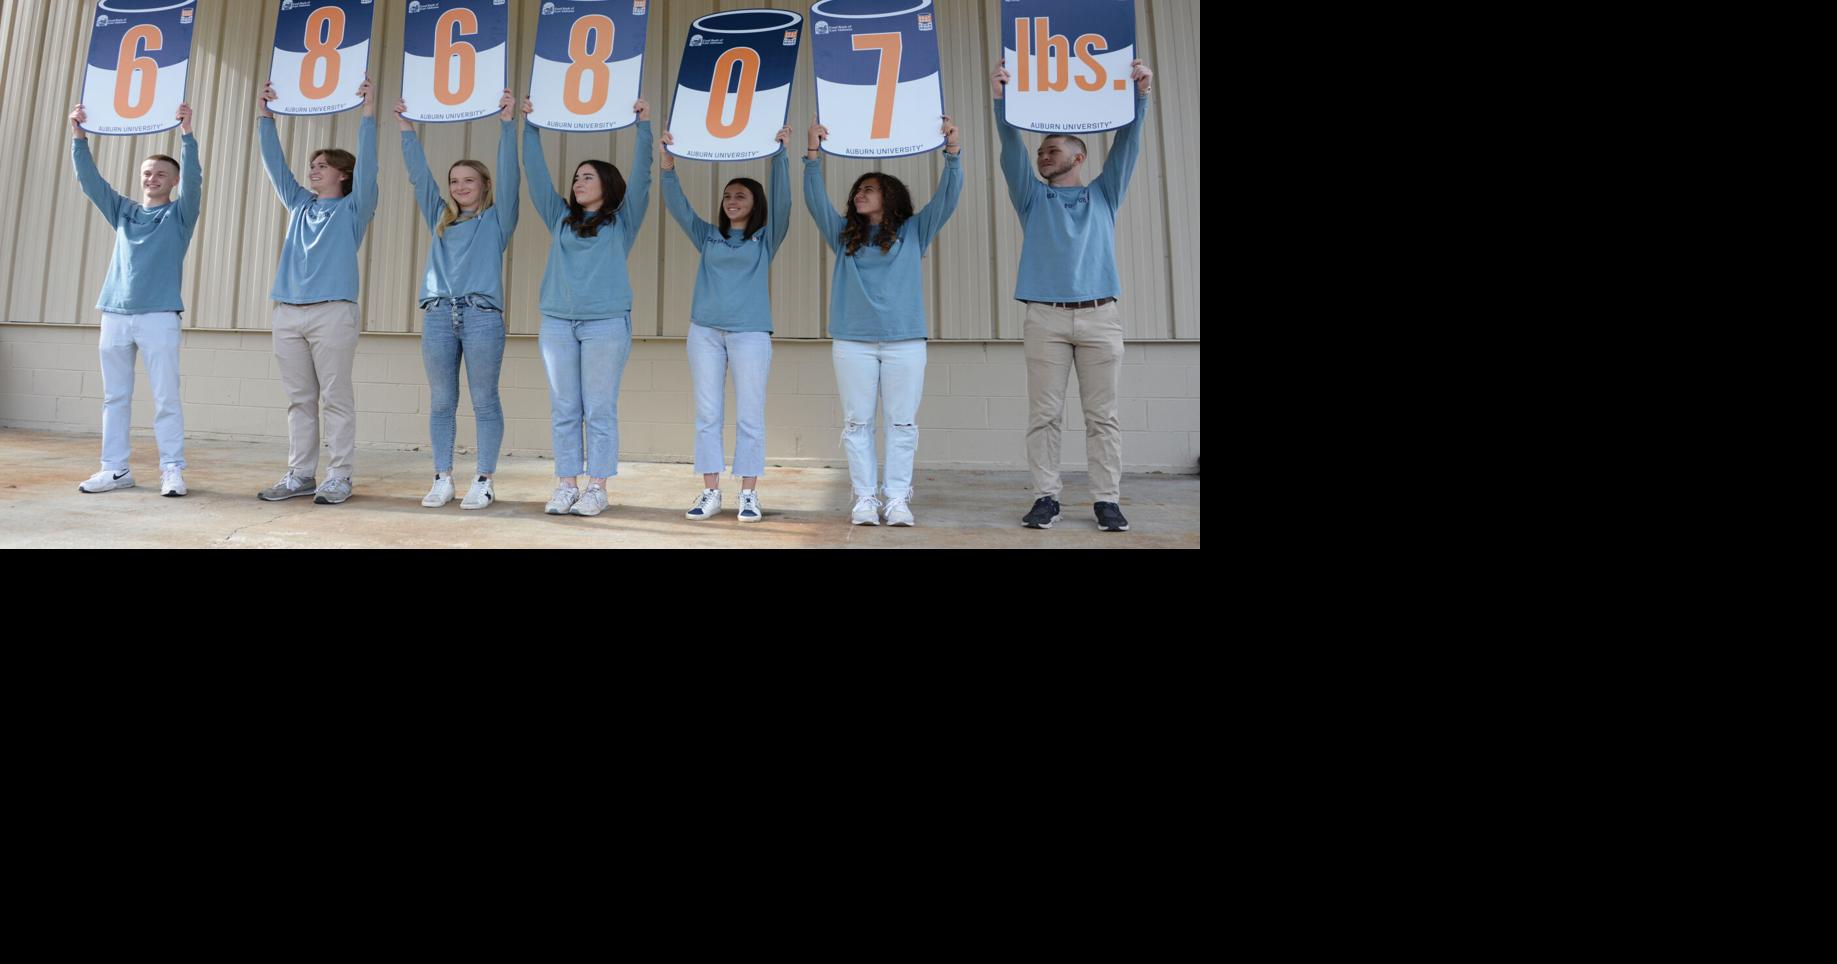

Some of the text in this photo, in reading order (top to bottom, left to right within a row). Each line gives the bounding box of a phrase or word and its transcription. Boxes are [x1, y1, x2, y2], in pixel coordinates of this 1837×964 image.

[113, 24, 163, 119] 6
[298, 6, 346, 100] 8
[433, 7, 478, 106] 6
[563, 14, 615, 115] 8
[705, 46, 760, 139] 0
[851, 31, 902, 140] 7
[1015, 16, 1126, 92] lbs.
[547, 120, 572, 128] AUBURN
[686, 150, 713, 158] AUBURN
[1030, 122, 1061, 130] AUBURN
